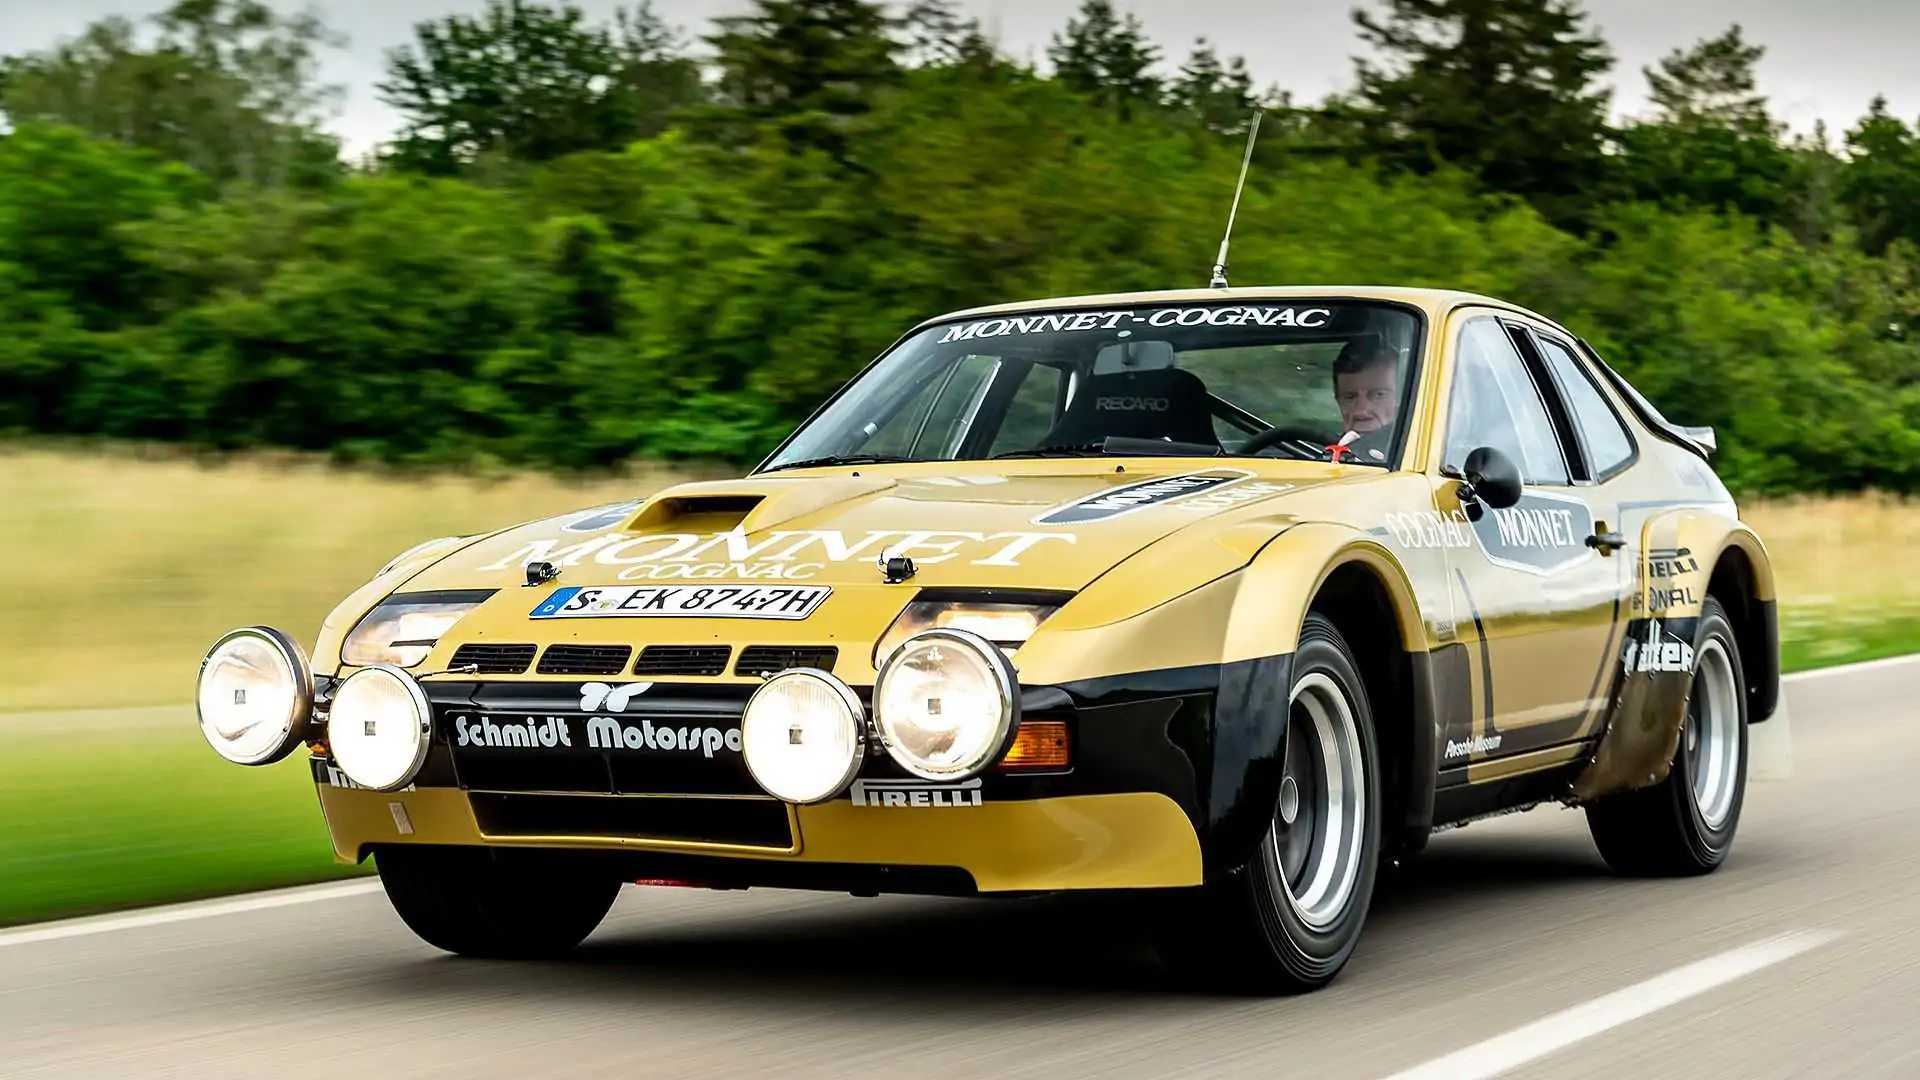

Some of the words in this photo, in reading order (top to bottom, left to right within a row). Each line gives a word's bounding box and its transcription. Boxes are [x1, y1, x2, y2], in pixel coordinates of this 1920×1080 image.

[937, 307, 1331, 344] MONNET-COGNAC
[1095, 395, 1169, 412] RECARO
[1385, 509, 1473, 548] COGNAC
[1494, 508, 1577, 551] MONNET
[475, 525, 1078, 572] MONNET
[616, 558, 825, 581] COGNAC
[563, 590, 602, 611] S
[616, 588, 681, 610] EK
[680, 588, 820, 612] 8747H
[455, 715, 572, 748] Schmidt
[587, 716, 743, 758] Motorspo
[850, 777, 983, 807] PIRELLI
